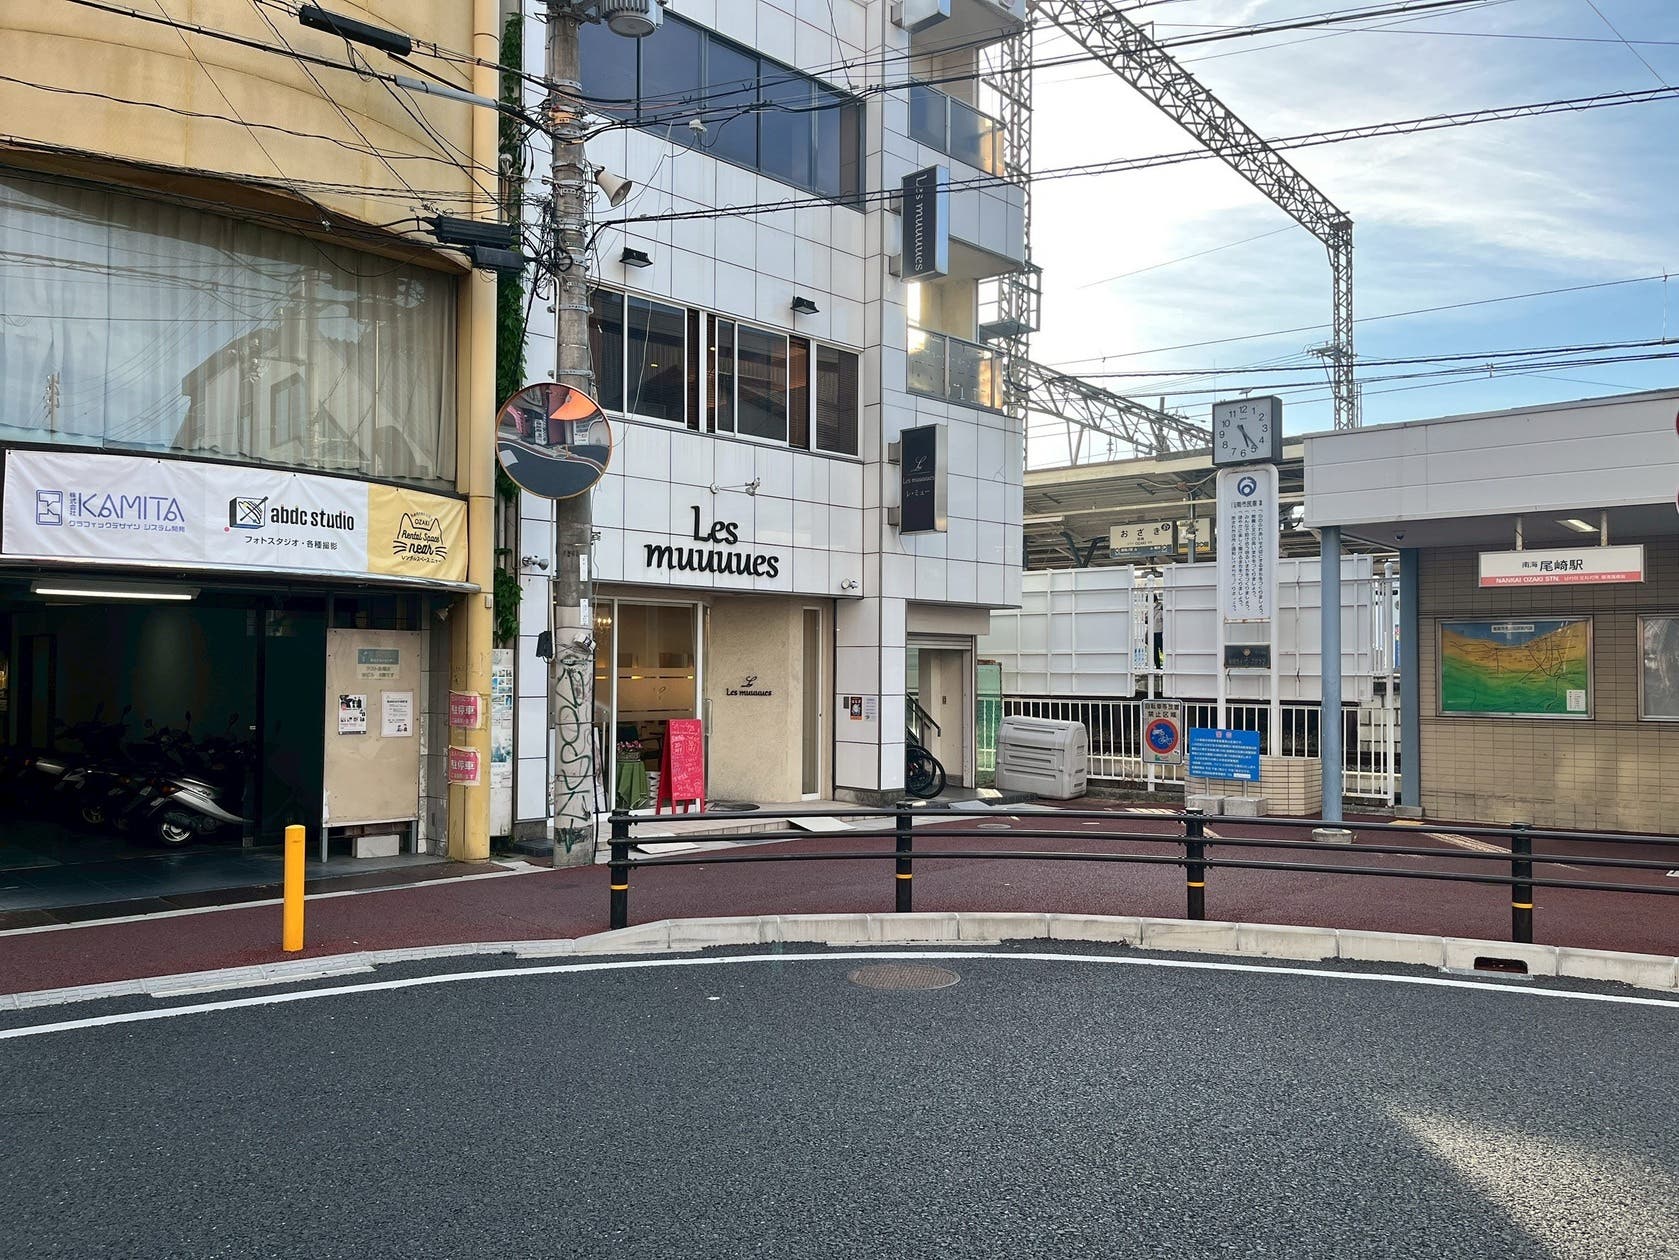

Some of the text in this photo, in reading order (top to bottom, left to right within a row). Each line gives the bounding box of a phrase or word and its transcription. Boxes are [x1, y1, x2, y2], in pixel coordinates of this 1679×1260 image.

[915, 174, 928, 200] Les
[1229, 410, 1236, 418] 11
[1239, 405, 1248, 414] 12
[1252, 407, 1256, 415] 1
[1259, 413, 1265, 421] 2
[1222, 419, 1230, 428] 10
[1262, 424, 1268, 432] 3
[1219, 430, 1225, 439] 9
[1222, 440, 1228, 449] 8
[1251, 445, 1257, 453] 5
[1232, 447, 1237, 456] 7
[1240, 449, 1246, 457] 6
[78, 492, 185, 523] KAMITA
[270, 504, 355, 531] abdc studio
[690, 505, 739, 545] Les
[401, 529, 440, 544] Rental Space
[408, 542, 434, 556] near
[643, 544, 780, 579] muuuues
[1522, 559, 1584, 572] 南海 尾崎駅
[726, 688, 738, 697] Les
[1148, 711, 1177, 719] 禁止区域
